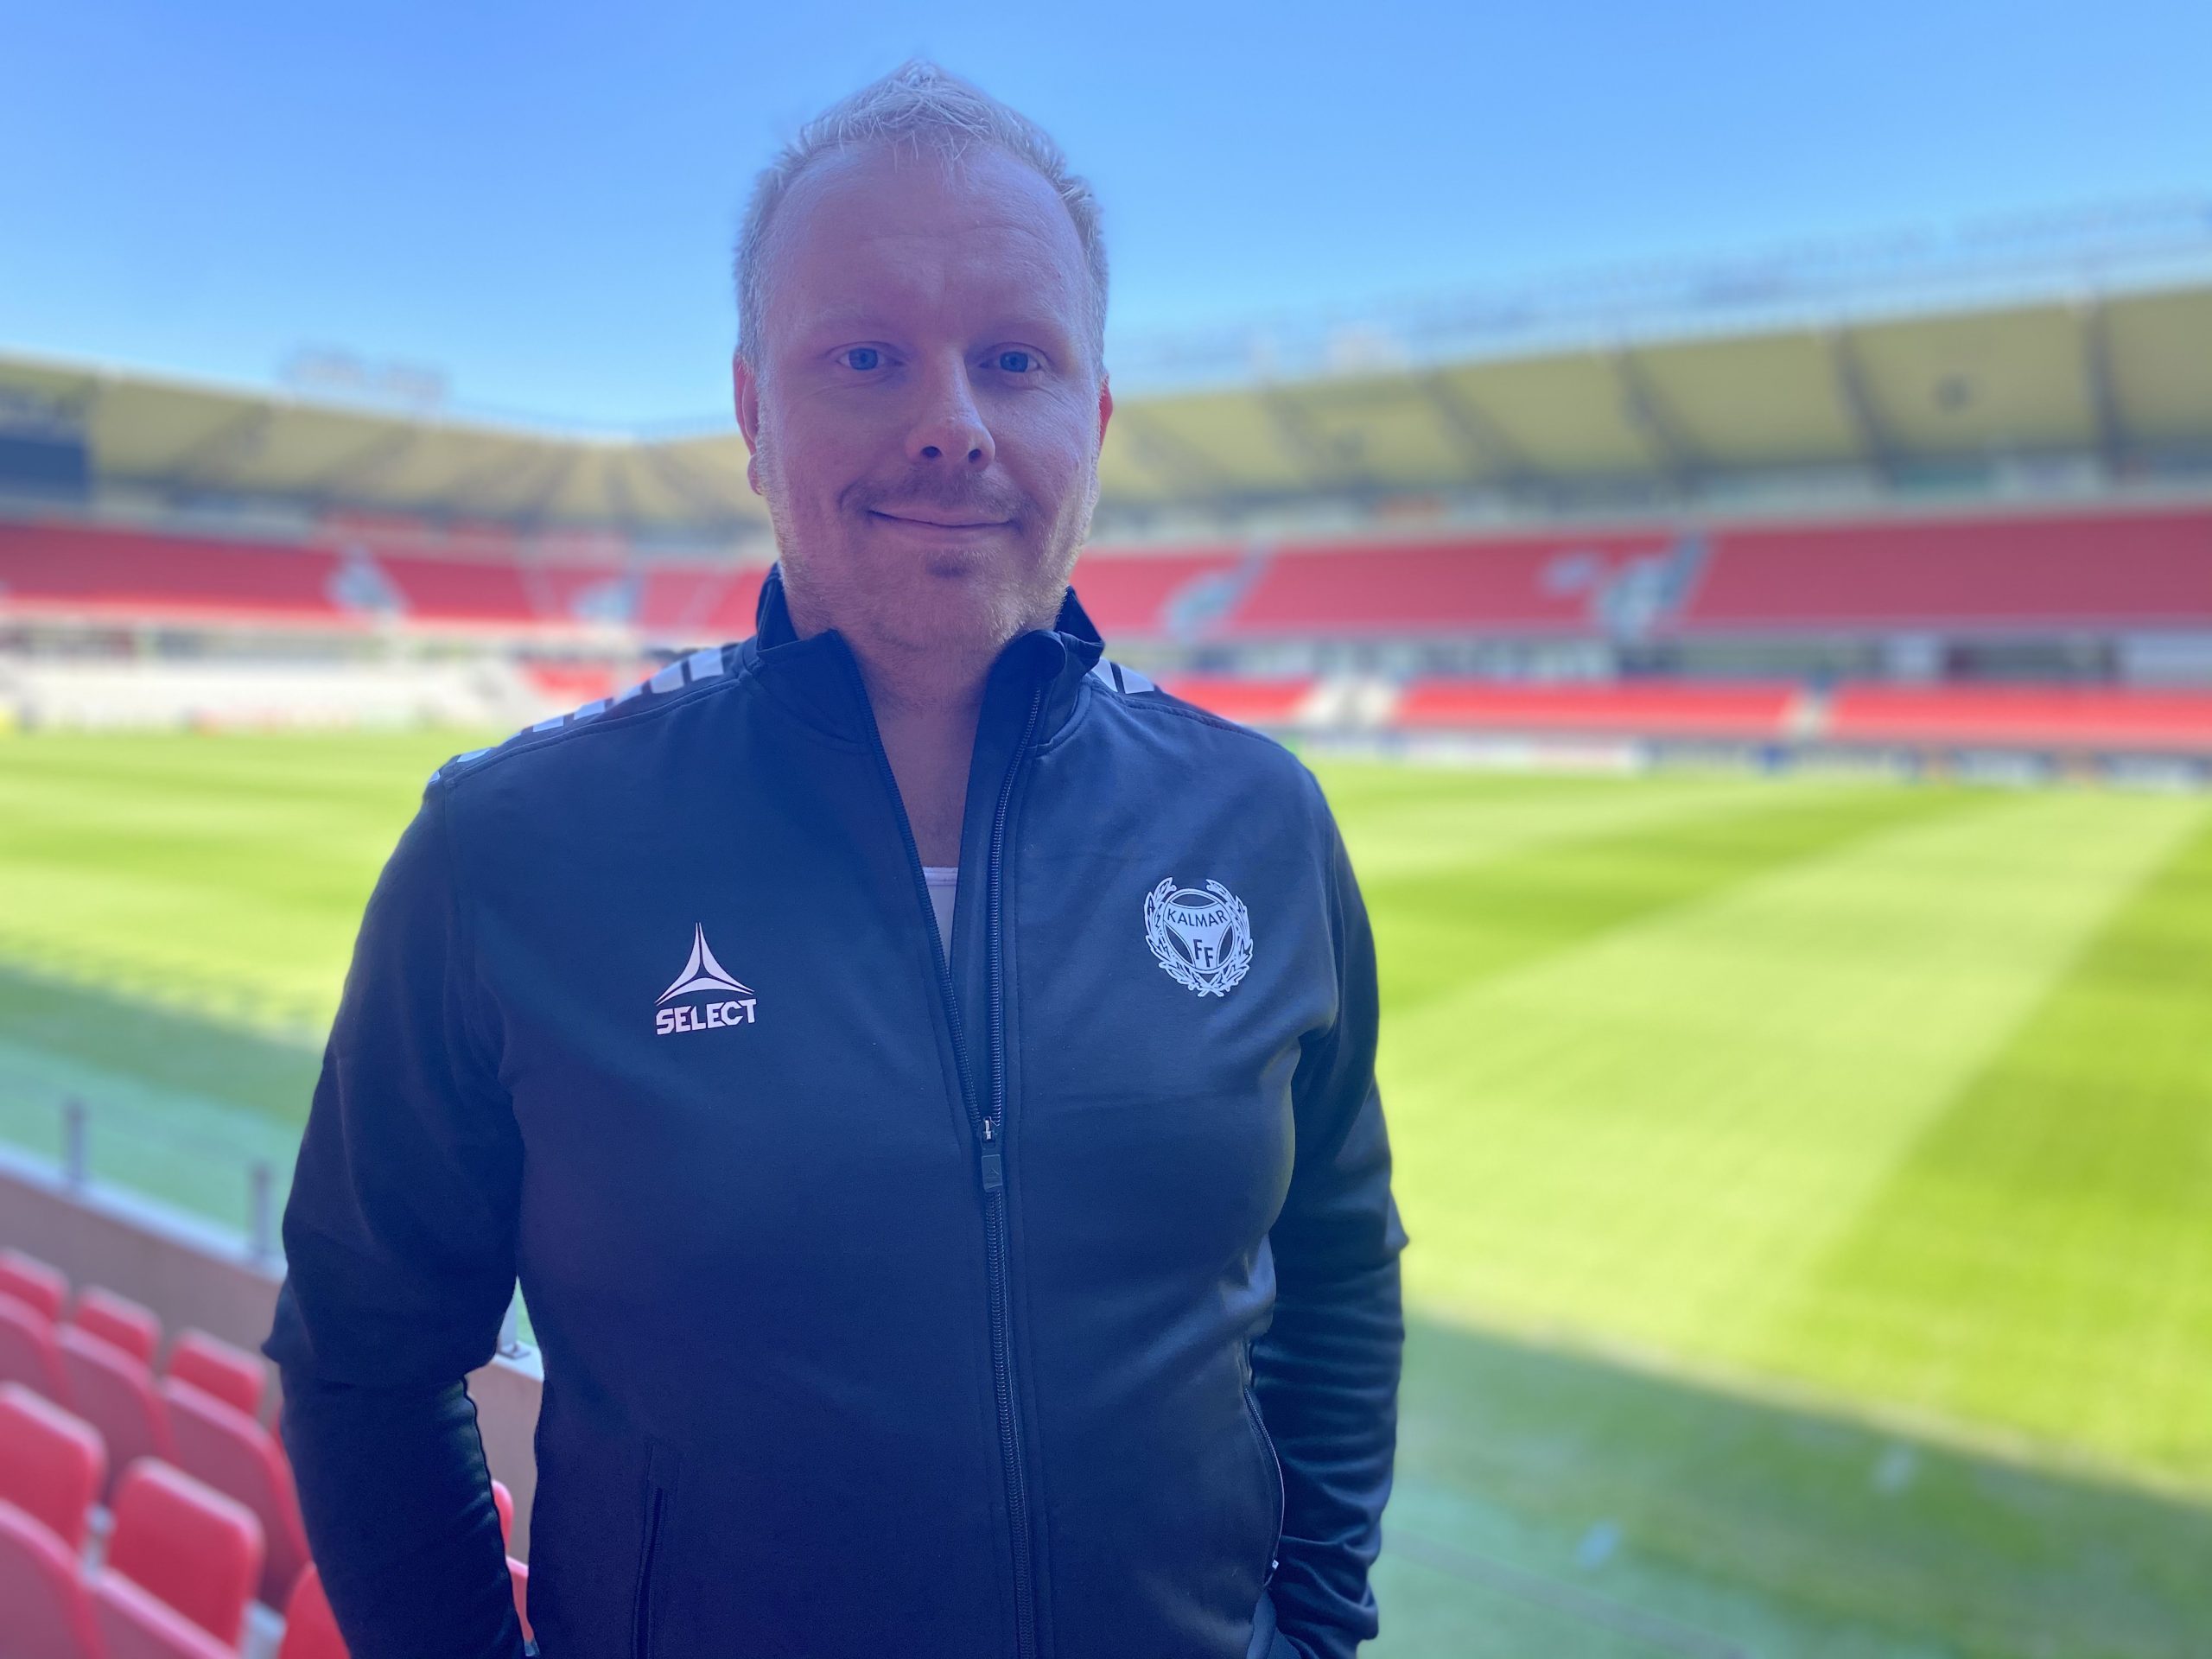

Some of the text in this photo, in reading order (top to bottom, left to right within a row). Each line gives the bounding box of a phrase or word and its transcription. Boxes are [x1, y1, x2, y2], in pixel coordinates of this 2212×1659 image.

[1167, 908, 1227, 927] KALMAR
[1193, 939, 1213, 968] FF
[656, 999, 757, 1034] SELECT
